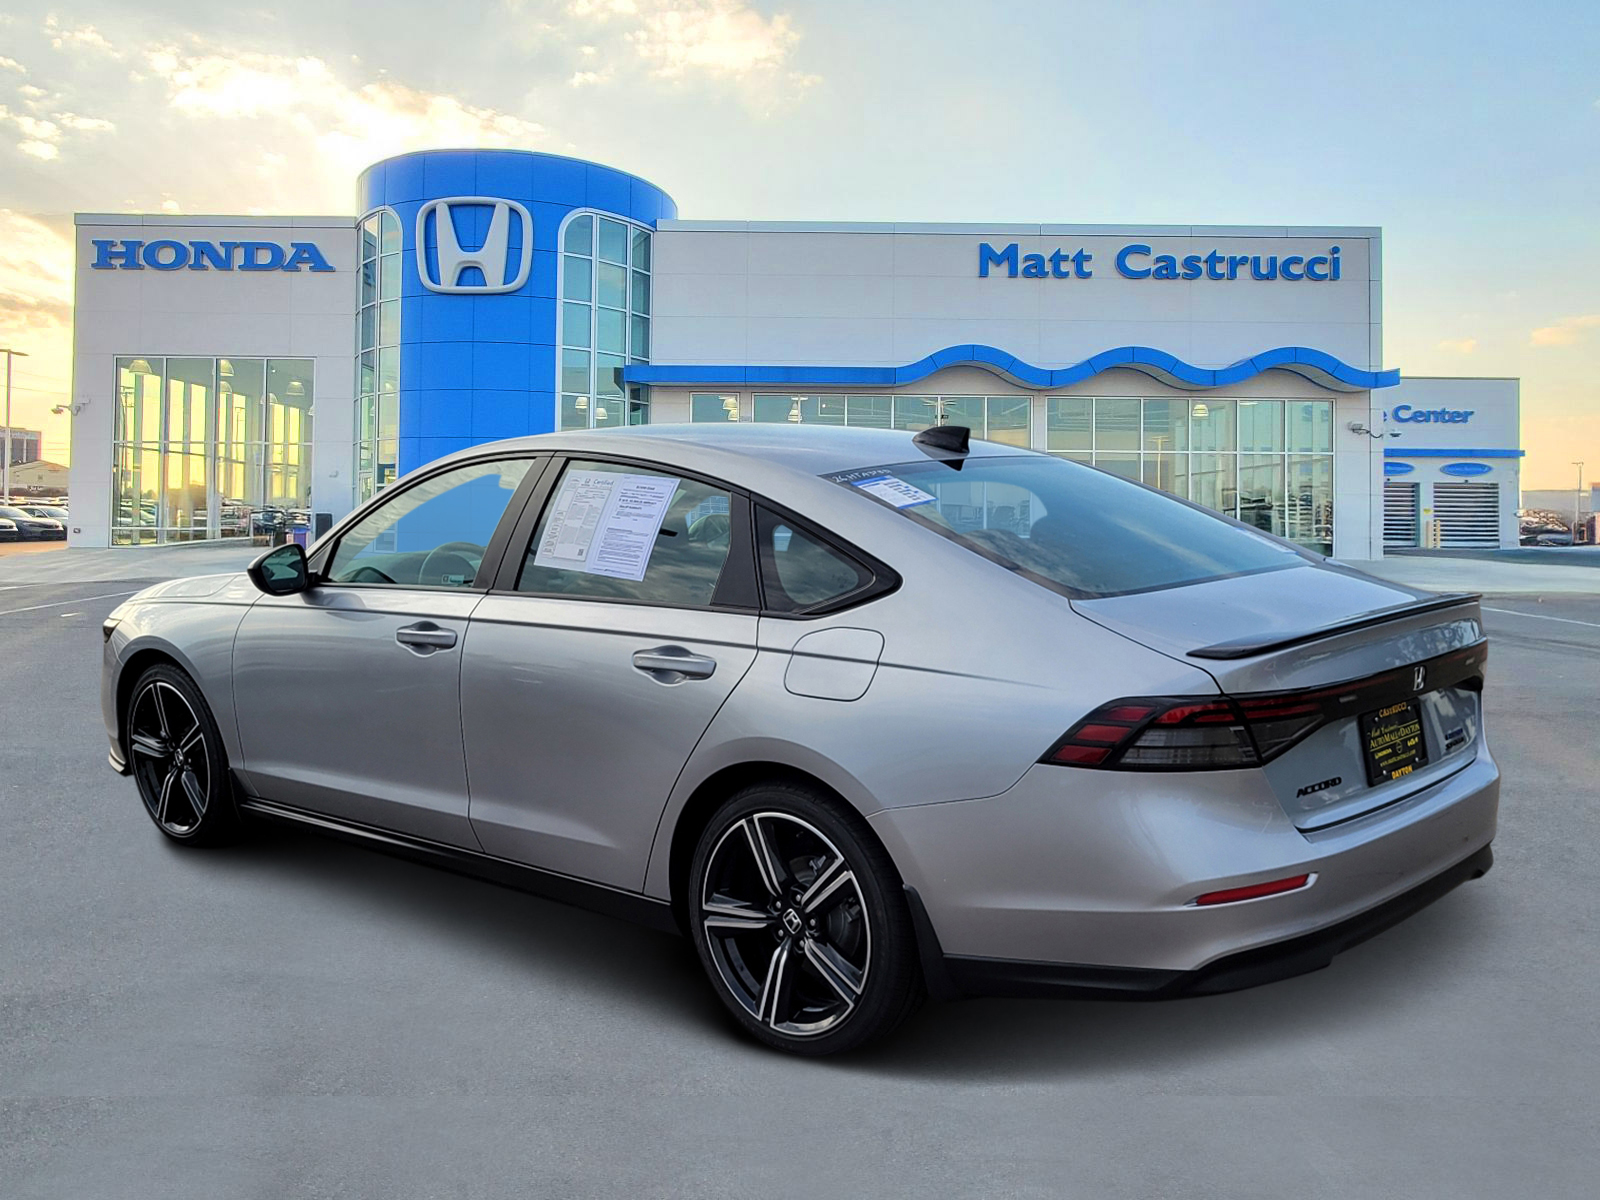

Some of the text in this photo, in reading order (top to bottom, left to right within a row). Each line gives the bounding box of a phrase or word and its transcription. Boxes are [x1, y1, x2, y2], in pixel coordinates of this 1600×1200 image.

[91, 239, 336, 272] HONDA
[978, 242, 1341, 281] Matt Castrucci
[1391, 404, 1475, 424] Center
[1391, 764, 1413, 780] DAYTON
[1296, 776, 1342, 798] ACCORD
